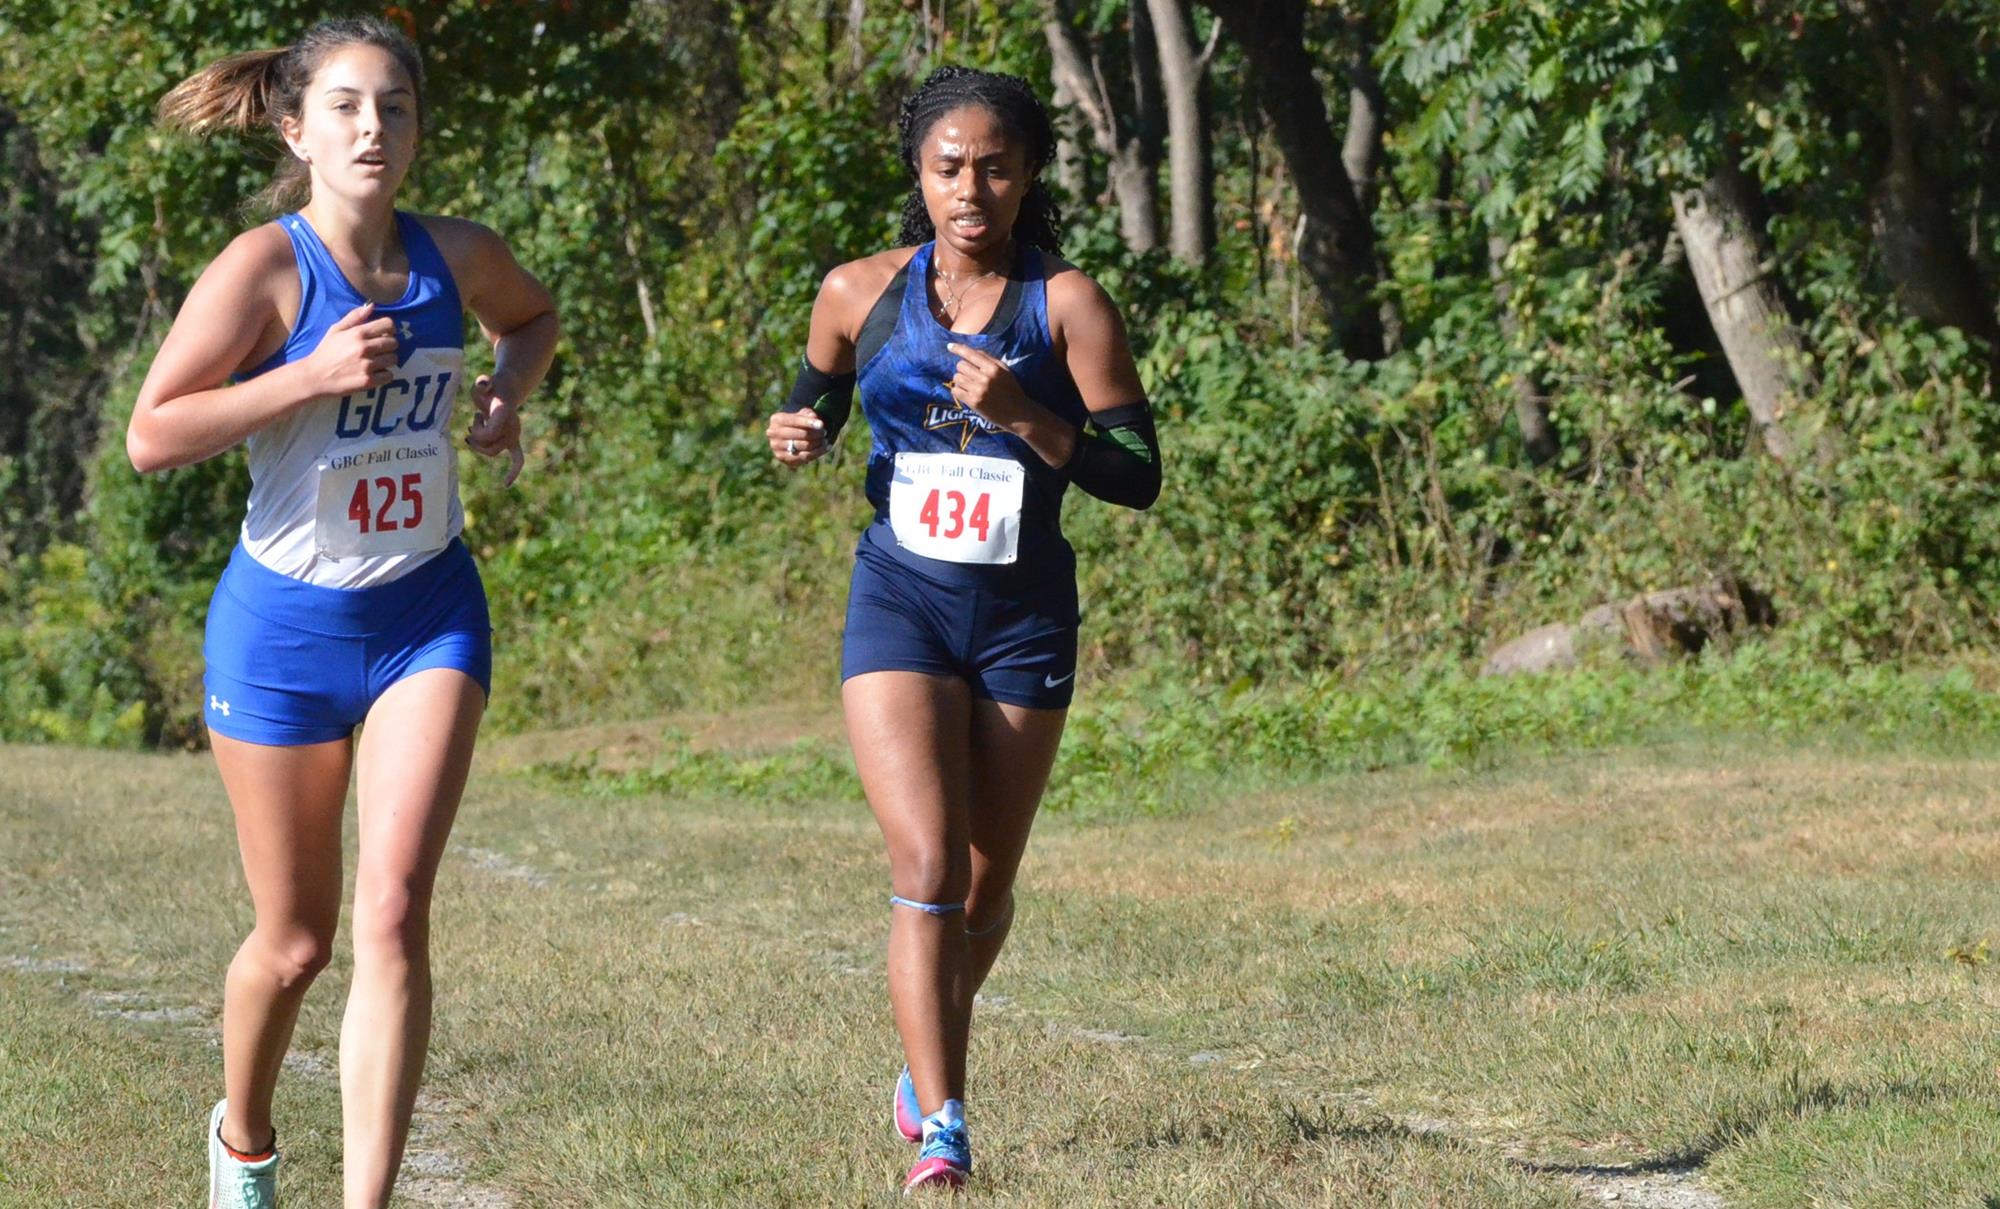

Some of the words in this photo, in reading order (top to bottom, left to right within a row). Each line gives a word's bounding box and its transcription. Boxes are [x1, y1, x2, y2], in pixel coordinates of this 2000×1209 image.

[336, 372, 452, 439] GCU
[331, 454, 364, 471] GBC
[367, 449, 392, 465] Fall
[396, 443, 439, 461] Classic
[969, 467, 1013, 483] Classic
[348, 473, 424, 534] 425
[919, 489, 991, 542] 434
